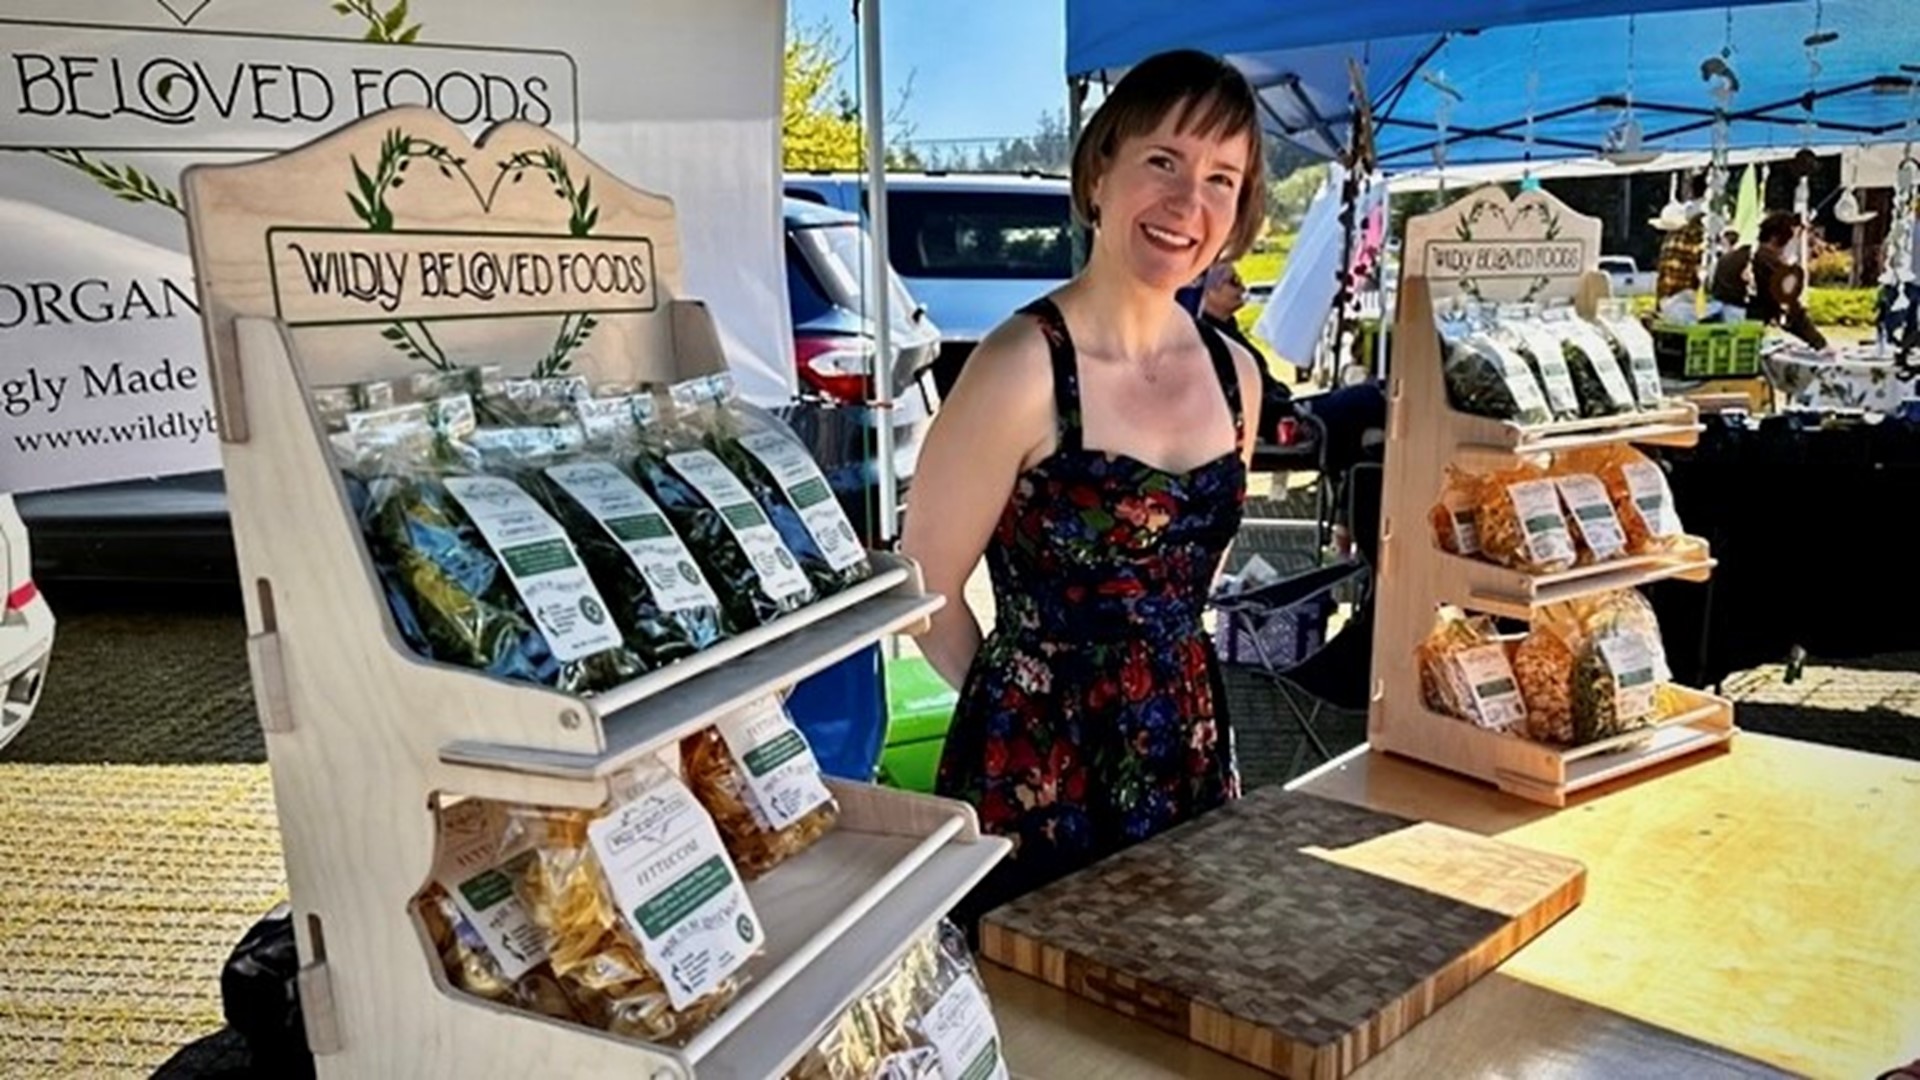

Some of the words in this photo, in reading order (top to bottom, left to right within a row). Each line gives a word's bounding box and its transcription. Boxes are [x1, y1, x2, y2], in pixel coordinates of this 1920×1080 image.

[12, 53, 333, 124] BELOVED
[352, 69, 554, 127] FOODS
[288, 243, 407, 311] WILDLY
[420, 251, 553, 299] BELOVED
[559, 253, 646, 294] FOODS
[80, 358, 198, 399] Made
